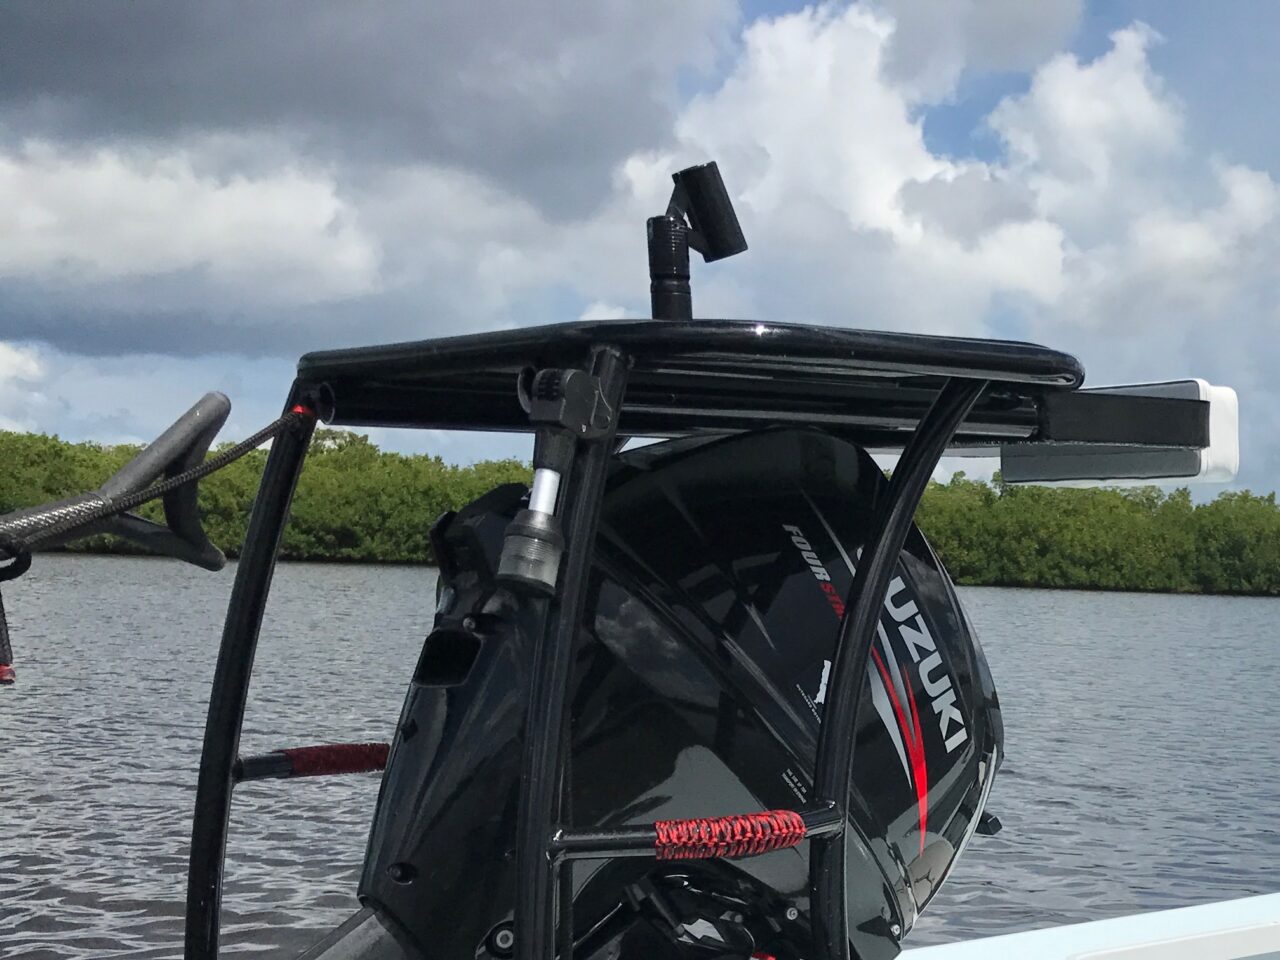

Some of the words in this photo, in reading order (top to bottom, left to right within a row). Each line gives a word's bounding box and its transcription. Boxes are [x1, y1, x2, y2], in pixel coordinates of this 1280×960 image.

[783, 524, 831, 582] FOUR
[820, 581, 845, 619] STR
[858, 547, 969, 753] UZUKI
